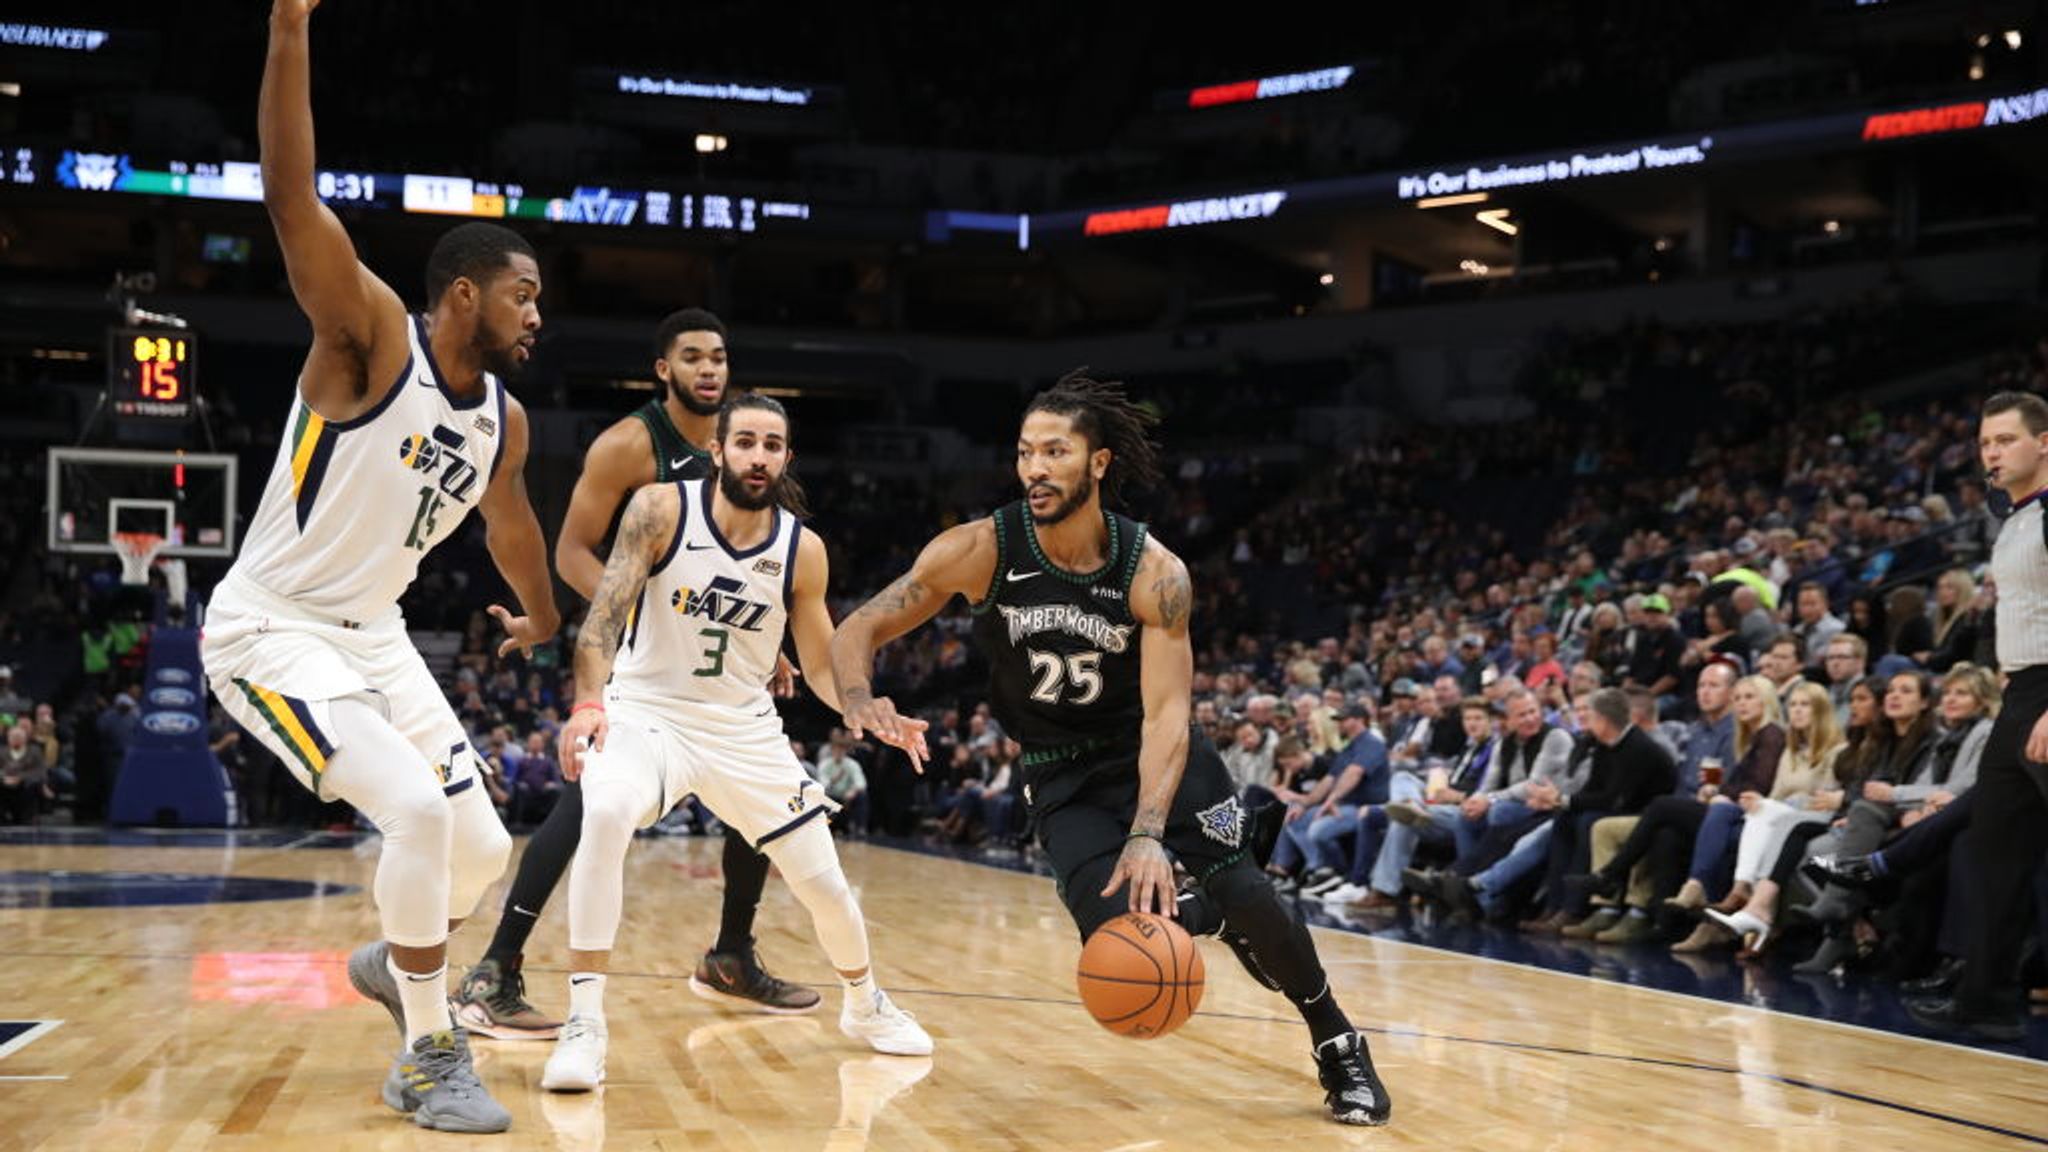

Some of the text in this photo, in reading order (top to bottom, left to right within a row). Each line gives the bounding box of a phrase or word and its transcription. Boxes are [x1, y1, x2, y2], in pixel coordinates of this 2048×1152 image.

[1427, 171, 1466, 195] Our
[1466, 163, 1548, 190] Business
[1547, 160, 1570, 181] to
[1570, 149, 1641, 177] Protect
[134, 336, 186, 363] 8:31
[142, 360, 178, 400] 15
[997, 604, 1137, 653] TIMBERWOLVES
[691, 628, 729, 677] 3
[1028, 649, 1104, 705] 25
